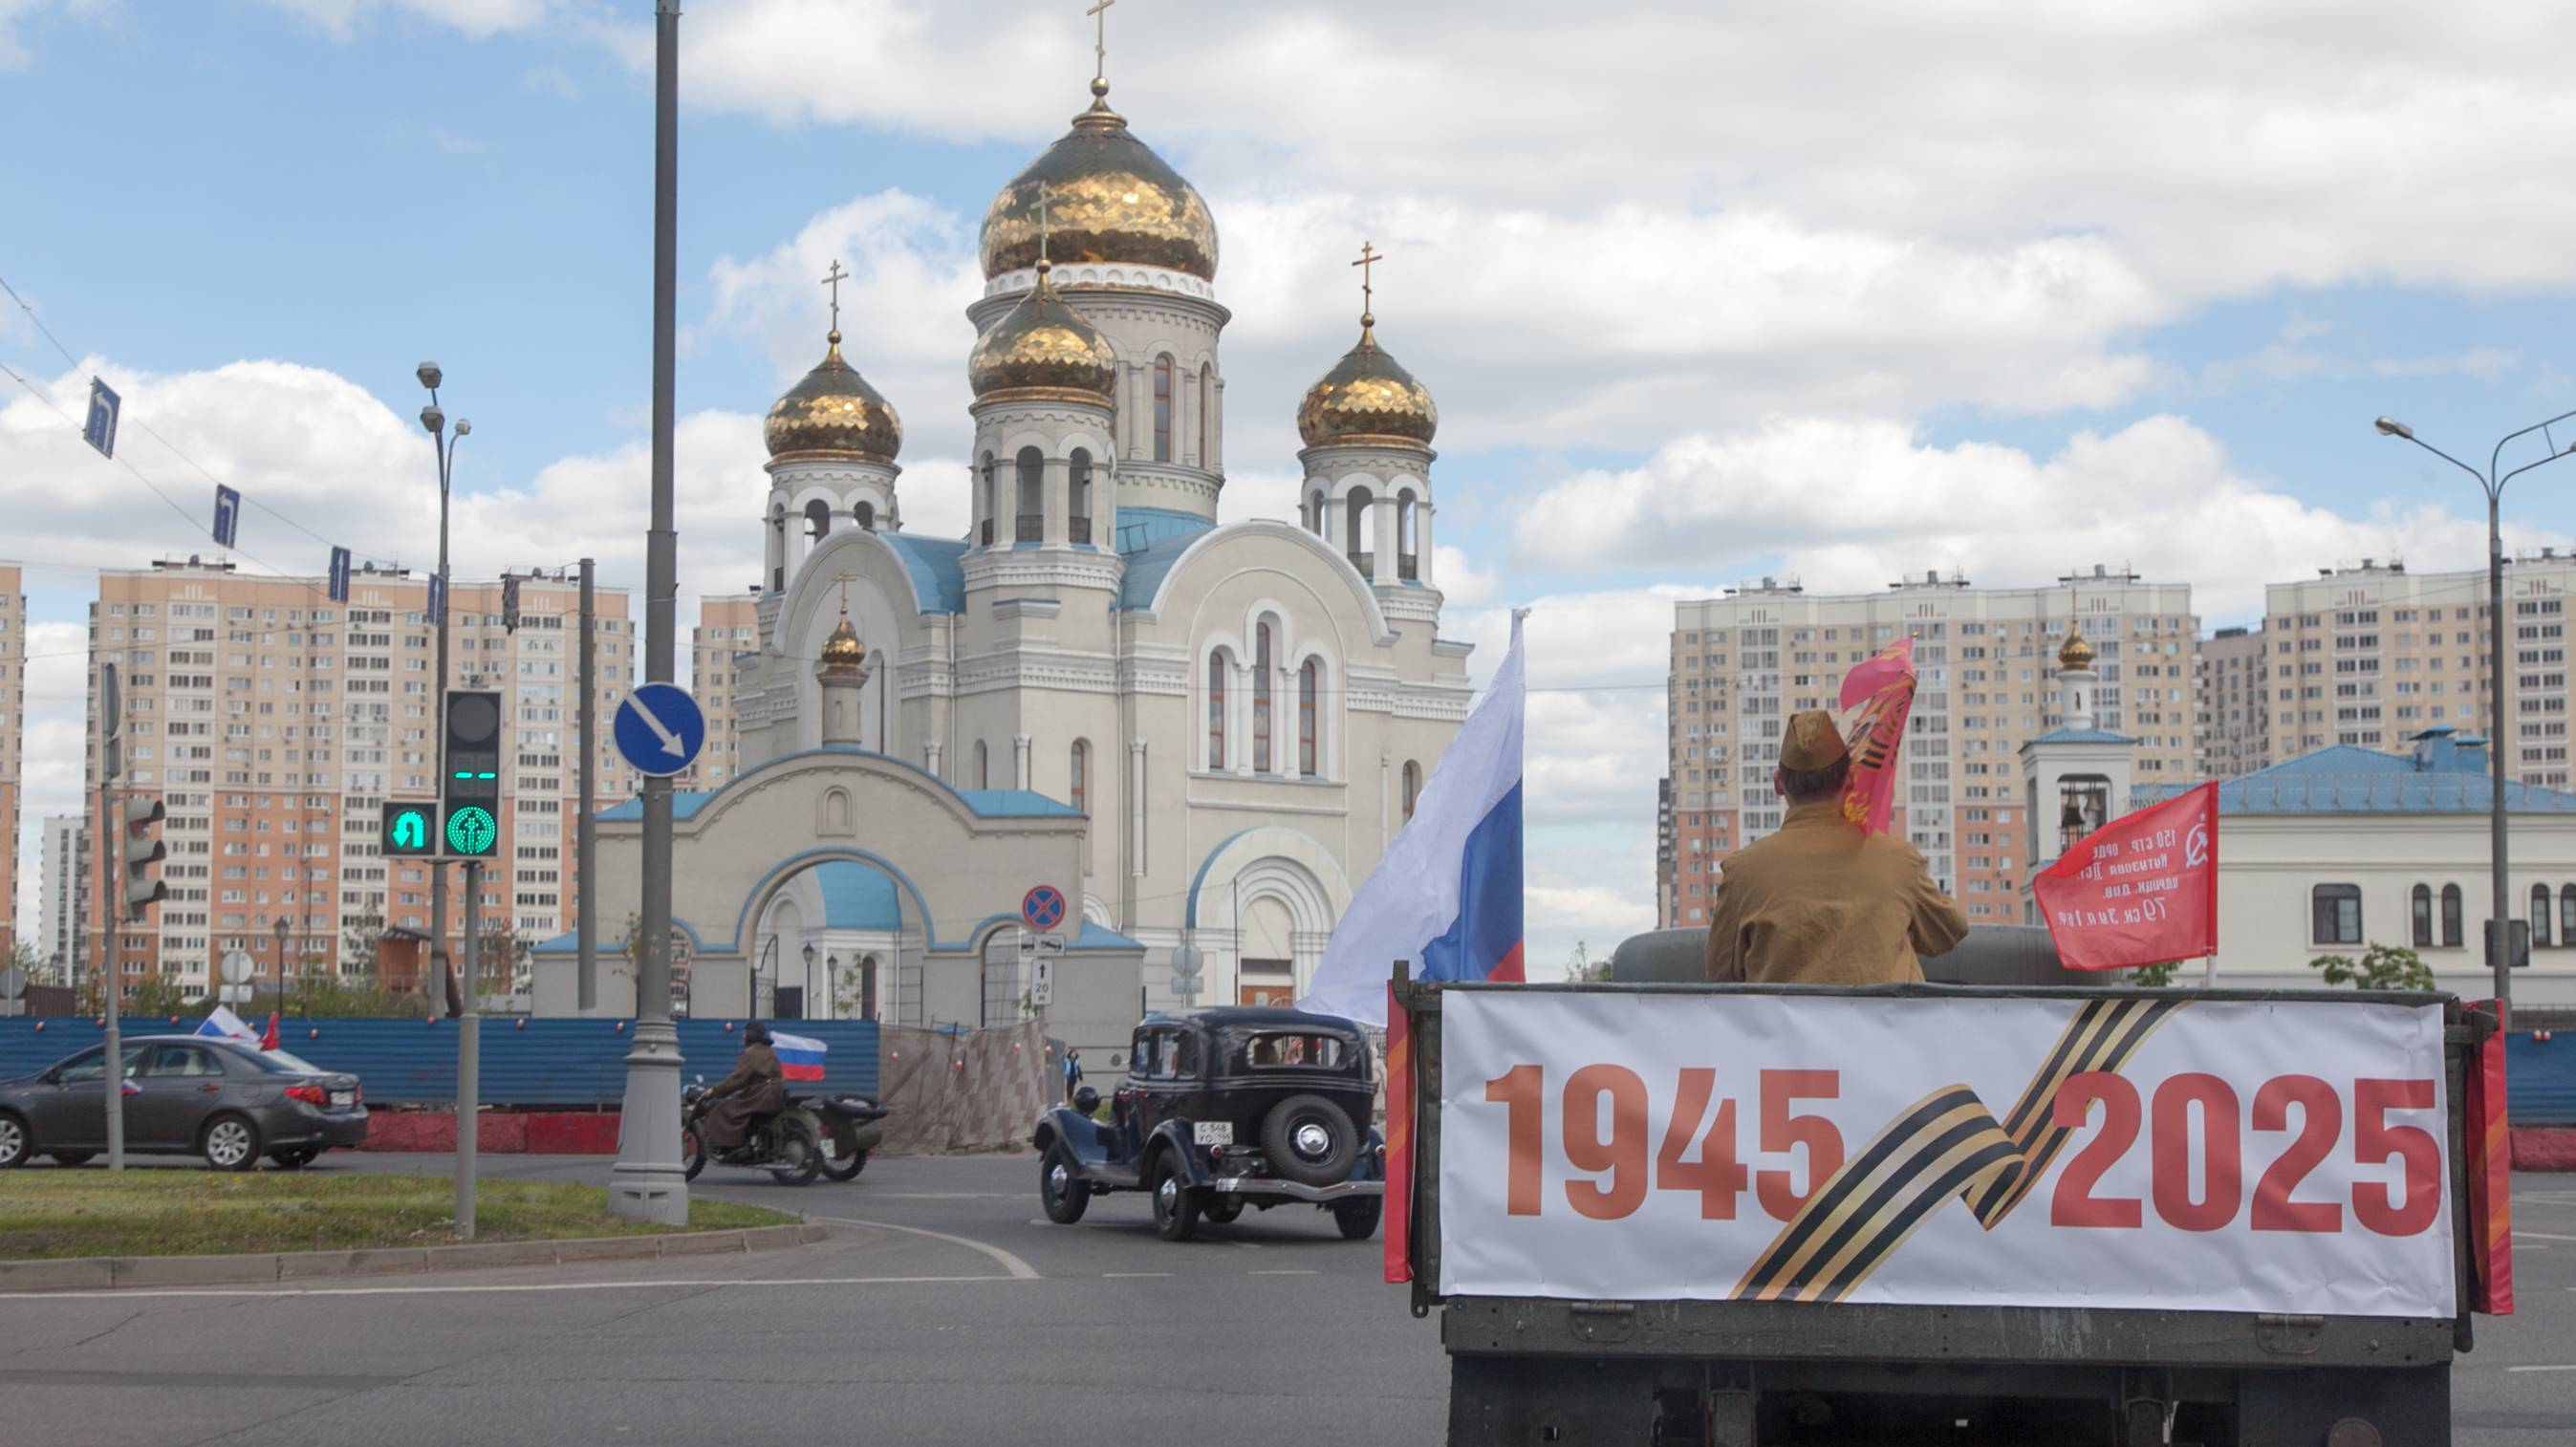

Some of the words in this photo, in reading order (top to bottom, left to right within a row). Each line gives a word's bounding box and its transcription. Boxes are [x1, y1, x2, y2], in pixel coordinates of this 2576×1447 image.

[1035, 983, 1049, 993] 20
[1485, 1063, 1845, 1223] 1945
[2051, 1071, 2442, 1238] 2025
